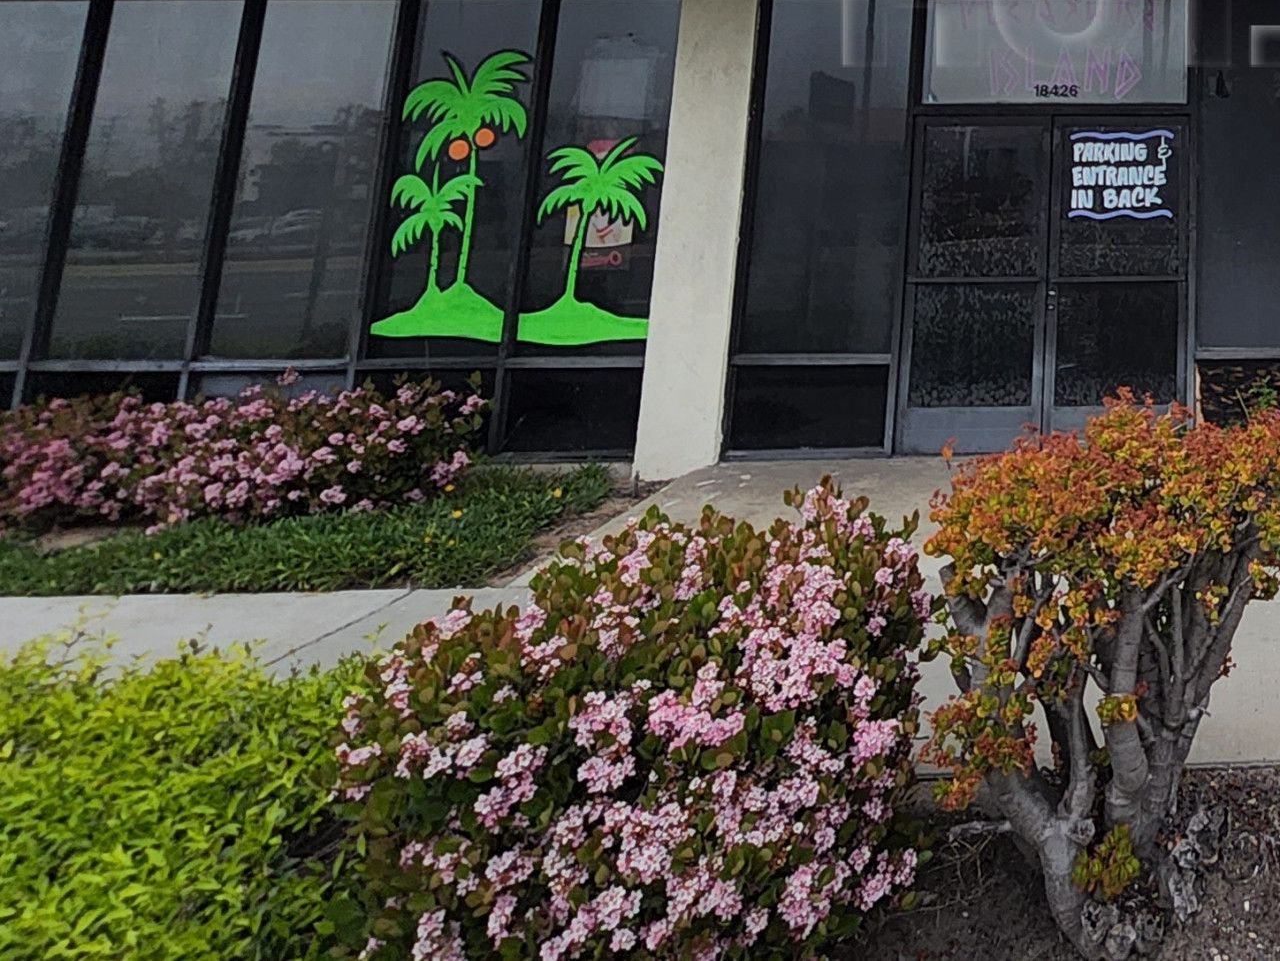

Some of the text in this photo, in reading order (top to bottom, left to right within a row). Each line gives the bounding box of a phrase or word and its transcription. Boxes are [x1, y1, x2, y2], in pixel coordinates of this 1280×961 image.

[989, 41, 1143, 100] ISLAND
[1033, 84, 1079, 98] 18426
[1073, 141, 1148, 164] PARKING
[1072, 164, 1167, 187] ENTRANCE
[1070, 186, 1163, 209] IN BACK
